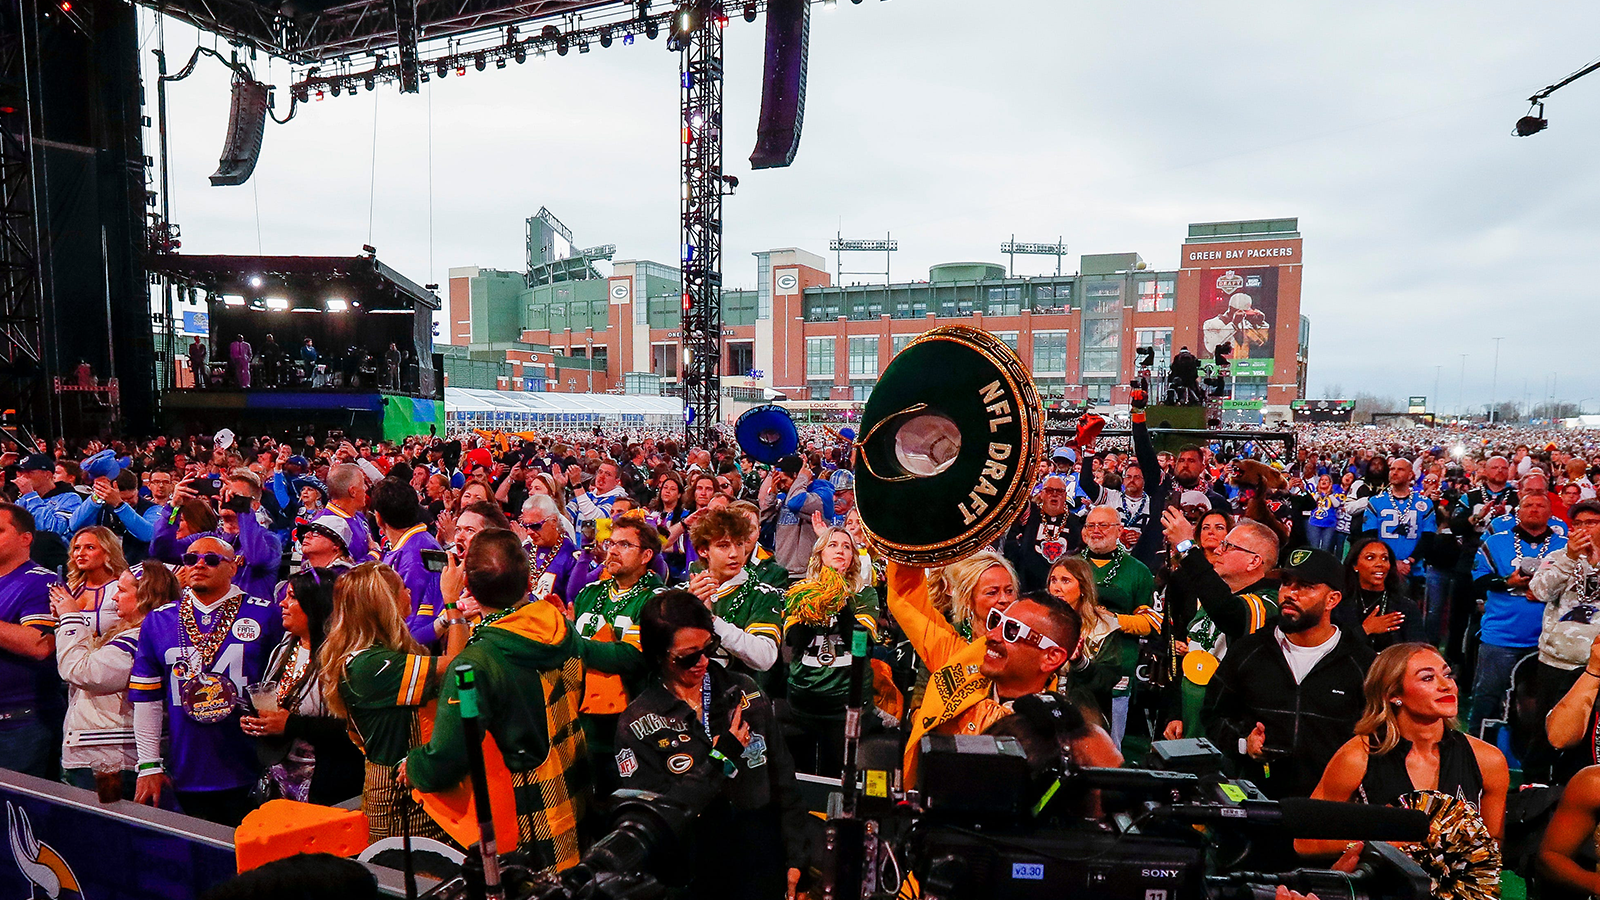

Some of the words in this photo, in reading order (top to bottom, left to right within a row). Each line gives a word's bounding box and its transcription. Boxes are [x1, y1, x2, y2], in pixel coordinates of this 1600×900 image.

[1189, 251, 1222, 260] GREEN
[1225, 249, 1245, 259] BAY
[1247, 247, 1293, 258] PACKERS
[978, 379, 1012, 433] NFL
[957, 442, 1012, 526] DRAFT
[619, 758, 636, 774] NFL
[1015, 866, 1041, 876] v3.30
[1141, 869, 1179, 878] SONY
